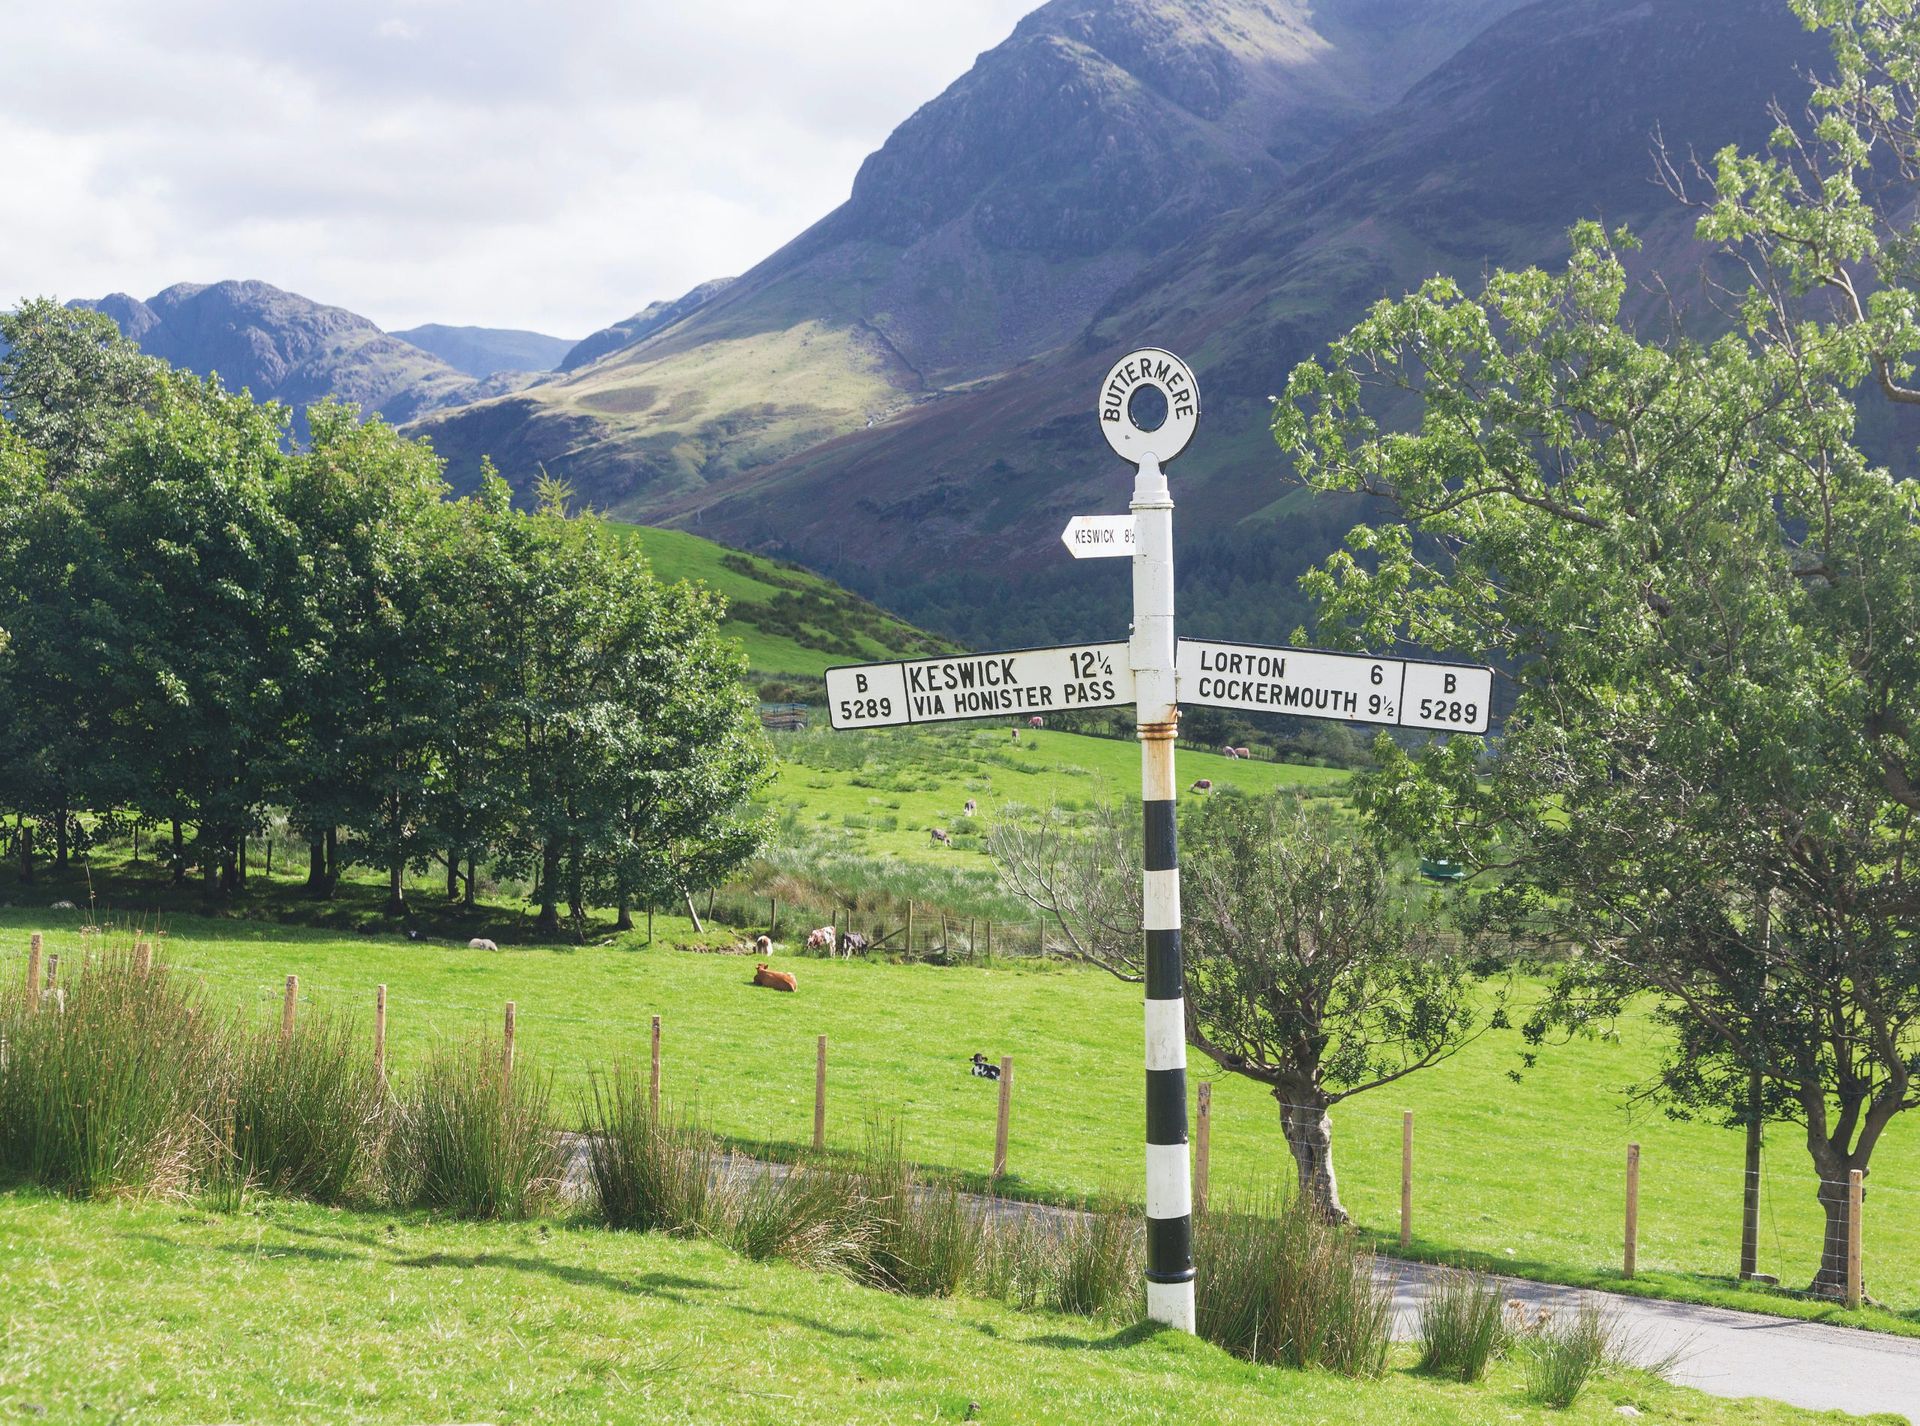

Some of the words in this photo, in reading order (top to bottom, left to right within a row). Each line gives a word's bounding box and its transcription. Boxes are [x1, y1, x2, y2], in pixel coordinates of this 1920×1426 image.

[1102, 357, 1194, 422] BUTTERMERE
[1074, 529, 1115, 544] KESWICK
[909, 658, 1018, 693] KESWICK
[1200, 650, 1286, 678] LORTON
[1370, 664, 1383, 685] 6
[855, 673, 869, 693] B
[913, 694, 946, 716] VIA
[954, 685, 1053, 713] HONISTER
[1063, 680, 1116, 704] PASS
[1199, 677, 1358, 713] COCKERMOUTH
[1443, 673, 1457, 694] B
[840, 697, 893, 721] 5289
[1419, 698, 1478, 724] 5289
